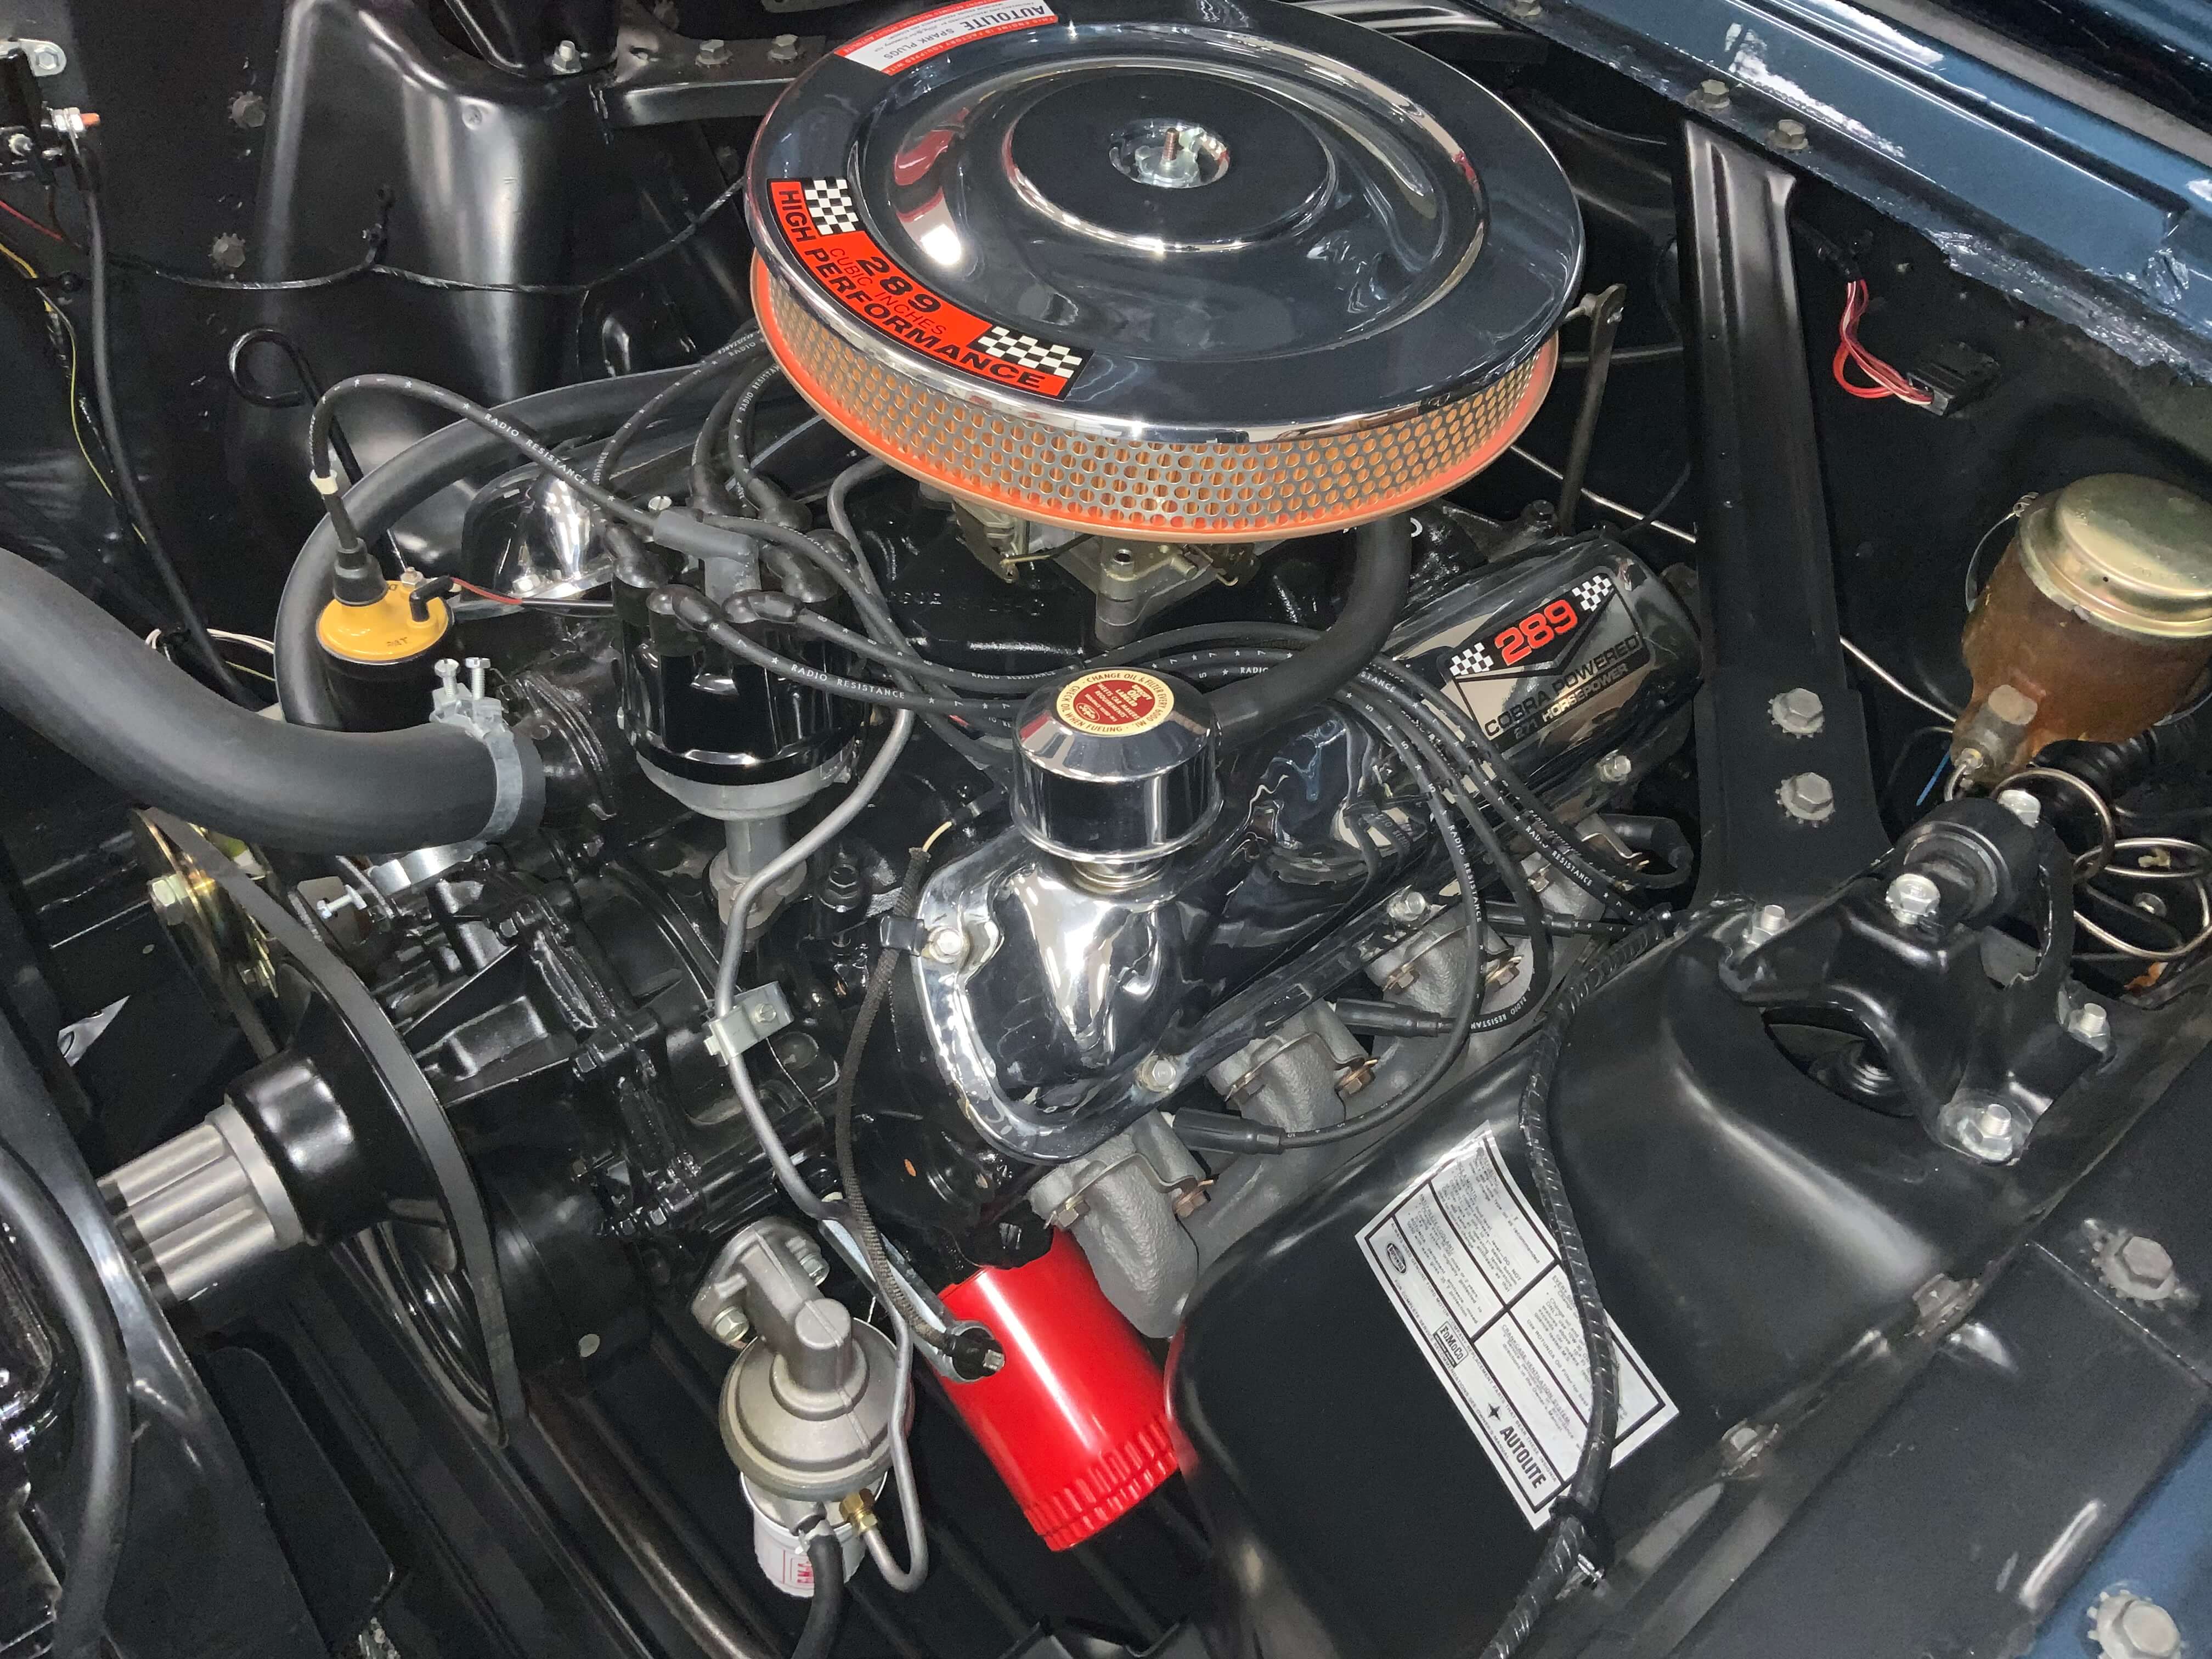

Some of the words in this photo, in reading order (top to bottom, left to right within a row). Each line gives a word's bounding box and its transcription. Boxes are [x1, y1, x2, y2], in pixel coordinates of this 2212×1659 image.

[961, 5, 1045, 31] AUTOLITE
[918, 28, 955, 44] SPARK
[884, 42, 918, 59] PLUGS
[779, 190, 817, 242] HIGH
[804, 247, 1046, 389] PERFORMANCE
[830, 248, 873, 286] CUBIC
[875, 291, 947, 335] INCHES
[856, 256, 941, 313] 289
[740, 392, 754, 413] RADIO
[484, 413, 520, 437] RADIO
[526, 439, 589, 486] RESISTANCE
[1494, 599, 1578, 666] 289
[791, 664, 827, 681] RADIO
[837, 679, 905, 699] RESISTANCE
[1087, 673, 1121, 683] CHANGE
[1124, 673, 1137, 681] OIL
[1144, 679, 1163, 694] FILTER
[1484, 690, 1551, 737] COBRA
[1552, 634, 1640, 695] POWERED
[1063, 685, 1080, 704] CHECK
[1115, 689, 1138, 708] LABELED
[1127, 690, 1141, 701] OIL
[1542, 663, 1629, 723] HORSEPOWER
[1060, 704, 1070, 713] OIL
[1079, 704, 1097, 720] Ford
[1111, 695, 1122, 704] CAR
[1120, 704, 1141, 720] MAKERS
[1149, 709, 1164, 722] 6000
[1065, 712, 1087, 729] WHEN
[1086, 724, 1122, 732] FUELING
[1448, 824, 1465, 855] RADIO
[1464, 862, 1482, 922] RESISTANCE
[1551, 850, 1593, 887] RESISTANCE
[1511, 1226, 1541, 1264] recommended
[1438, 1325, 1466, 1361] FoMoCo
[1534, 1329, 1556, 1359] ROTUNDA
[1498, 1424, 1548, 1489] AUTOLITE
